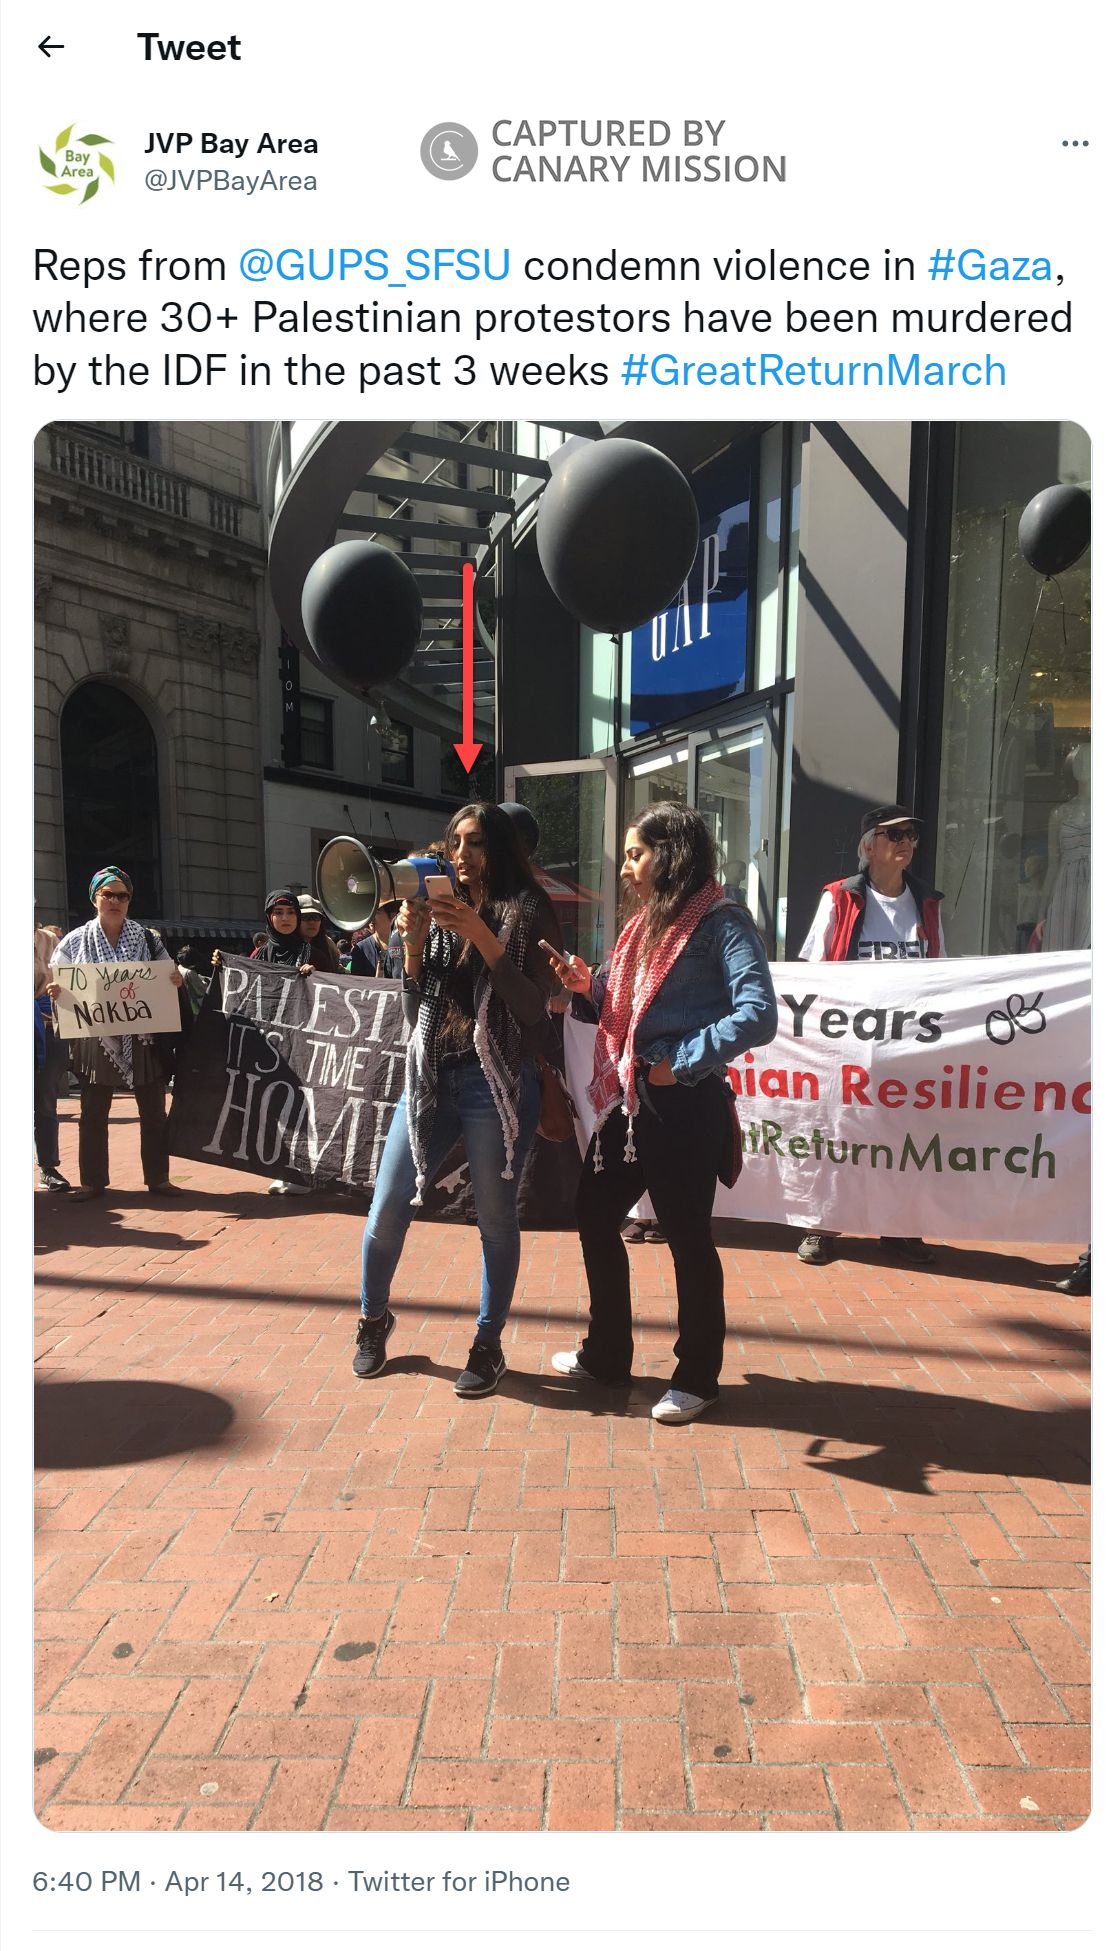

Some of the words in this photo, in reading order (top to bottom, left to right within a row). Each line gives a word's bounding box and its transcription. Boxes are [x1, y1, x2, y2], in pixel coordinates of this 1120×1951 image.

[58, 967, 87, 991] 70
[96, 967, 158, 991] Years
[119, 982, 139, 1000] of
[73, 1000, 152, 1029] Nakba
[781, 993, 945, 1044] Years
[226, 1023, 284, 1074] IT'S
[306, 1039, 371, 1093] TIME
[841, 1063, 1091, 1115] Resilienc
[202, 1068, 398, 1189] HOME
